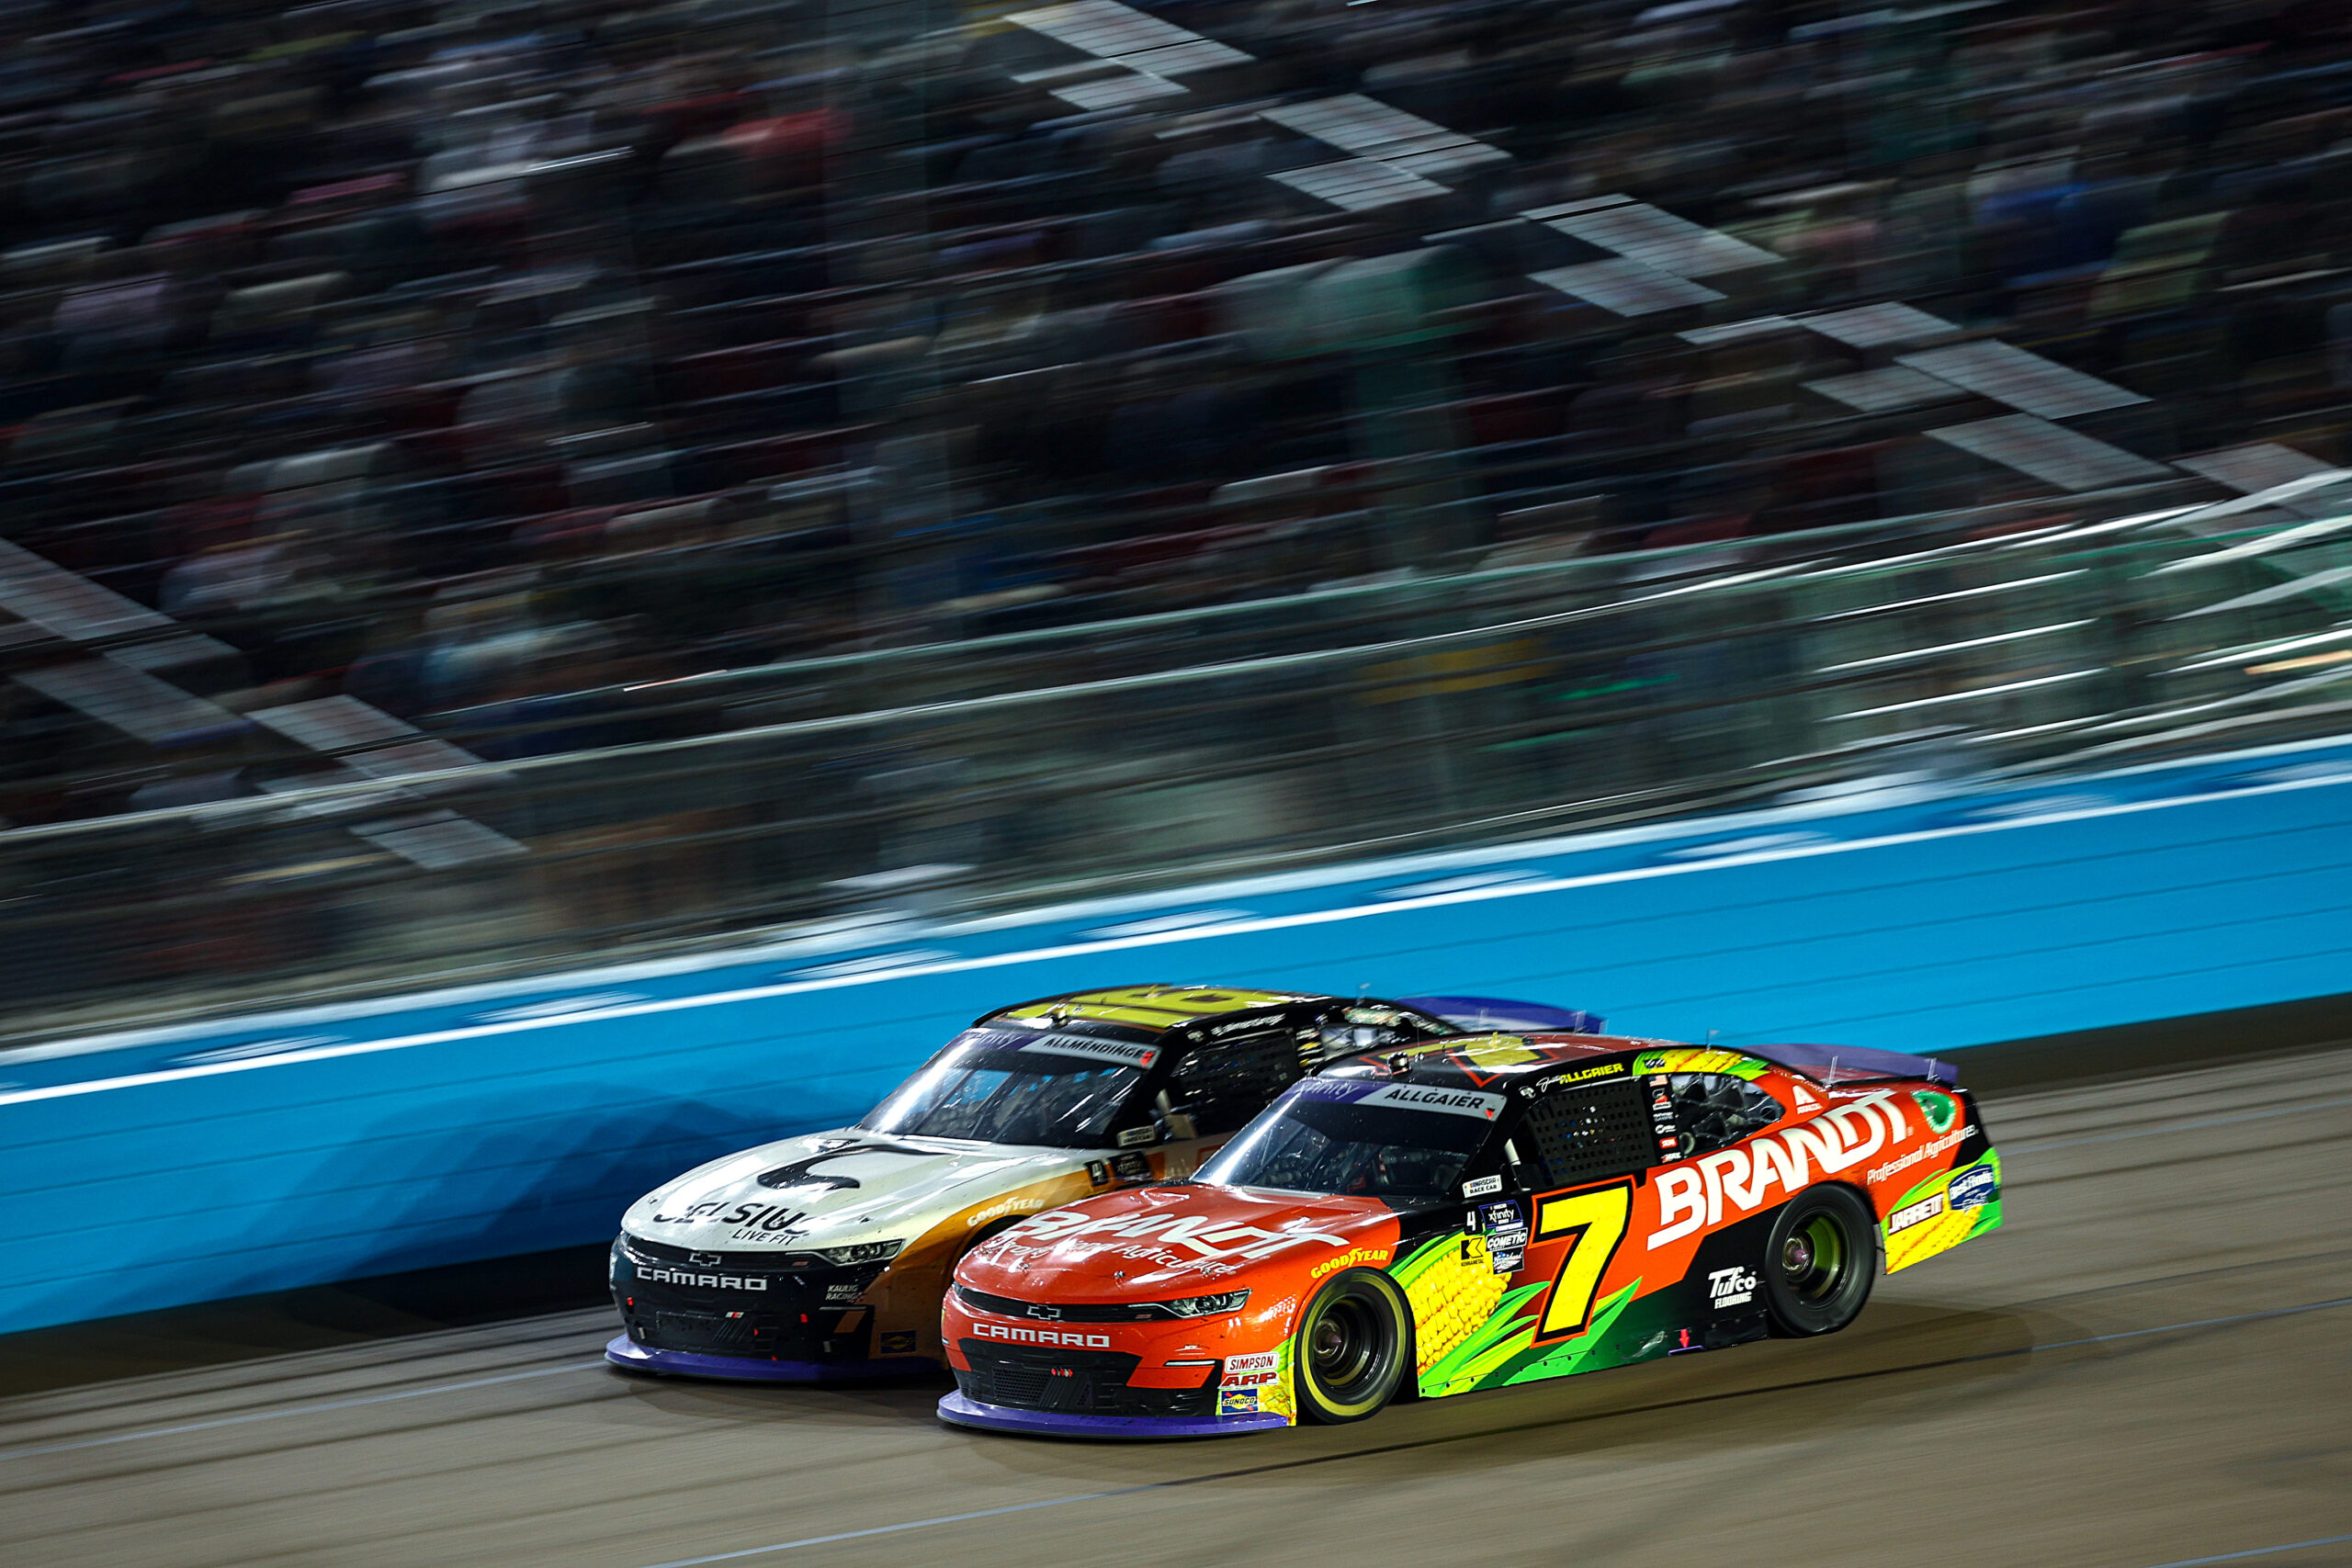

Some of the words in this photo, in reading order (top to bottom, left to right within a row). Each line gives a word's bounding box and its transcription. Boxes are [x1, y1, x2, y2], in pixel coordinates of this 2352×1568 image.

[1559, 1062, 1625, 1085] ALLGAIER
[1385, 1088, 1486, 1110] ALLGAIER
[1646, 1089, 1906, 1251] BRANDT
[1470, 1186, 1485, 1194] RACE
[1466, 1211, 1476, 1232] 4
[1487, 1209, 1514, 1223] xfinity
[732, 1228, 771, 1242] LIVE
[769, 1234, 799, 1247] FIT
[1487, 1231, 1527, 1249] COMETIC
[1310, 1247, 1389, 1279] GOODYEAR
[1532, 1179, 1634, 1344] 7
[637, 1266, 768, 1291] CAMARO
[1708, 1266, 1757, 1298] Tufco
[825, 1292, 858, 1302] RACING
[973, 1322, 1111, 1348] CAMARO
[1229, 1355, 1274, 1371] SIMPSON
[1221, 1371, 1277, 1387] ARP
[1224, 1396, 1256, 1406] SUNOCO
